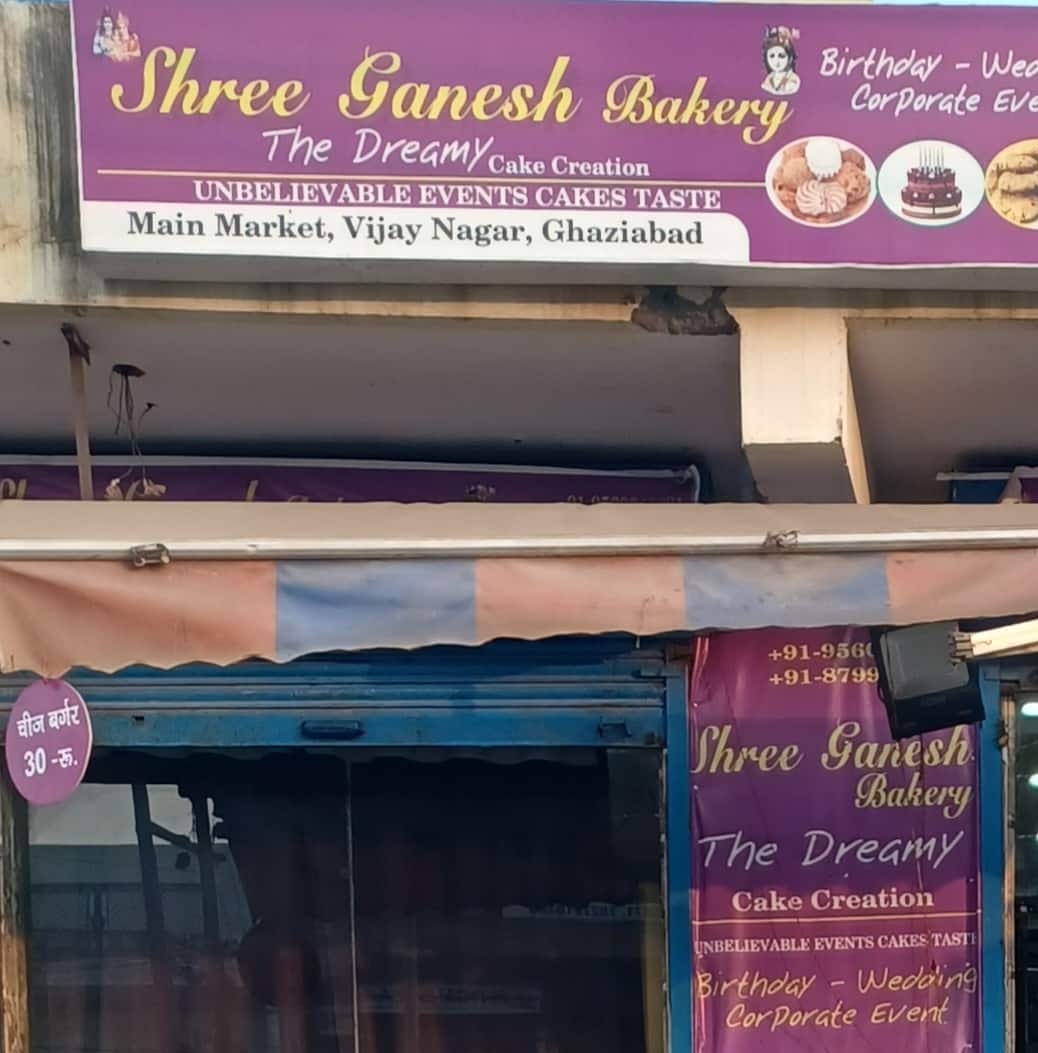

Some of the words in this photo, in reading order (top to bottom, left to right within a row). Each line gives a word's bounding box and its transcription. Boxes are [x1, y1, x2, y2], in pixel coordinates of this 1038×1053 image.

[819, 47, 943, 82] Birthday
[111, 45, 311, 117] Shree
[339, 45, 583, 124] Ganesh
[602, 74, 794, 145] Bakery
[850, 83, 981, 117] Corporate
[262, 126, 332, 165] The
[352, 127, 495, 169] Dreamy
[488, 154, 547, 176] Cake
[551, 155, 651, 177] Creation
[194, 180, 412, 206] UNBELIEVABLE
[419, 184, 528, 207] EVENTS
[534, 186, 627, 209] CAKES
[632, 188, 721, 210] TASTE
[128, 212, 204, 238] Main
[214, 211, 334, 242] Market,
[342, 215, 421, 249] Vijay
[431, 217, 533, 250] Nagar,
[542, 218, 703, 246] Ghaziabad
[768, 642, 873, 661] +91-956
[768, 667, 879, 685] +91-8799
[24, 747, 46, 777] 30
[821, 721, 972, 770] Ganesh
[855, 772, 973, 819] Bakery
[698, 830, 778, 870] The
[801, 830, 964, 869] Dreamy
[732, 891, 803, 912] Cake
[811, 889, 934, 909] Creation
[814, 936, 874, 951] EVENTS
[878, 934, 929, 949] CAKES
[697, 971, 816, 998] Birthday
[858, 966, 977, 993] Wedding
[726, 1000, 856, 1031] Corporate
[871, 997, 949, 1025] Event
